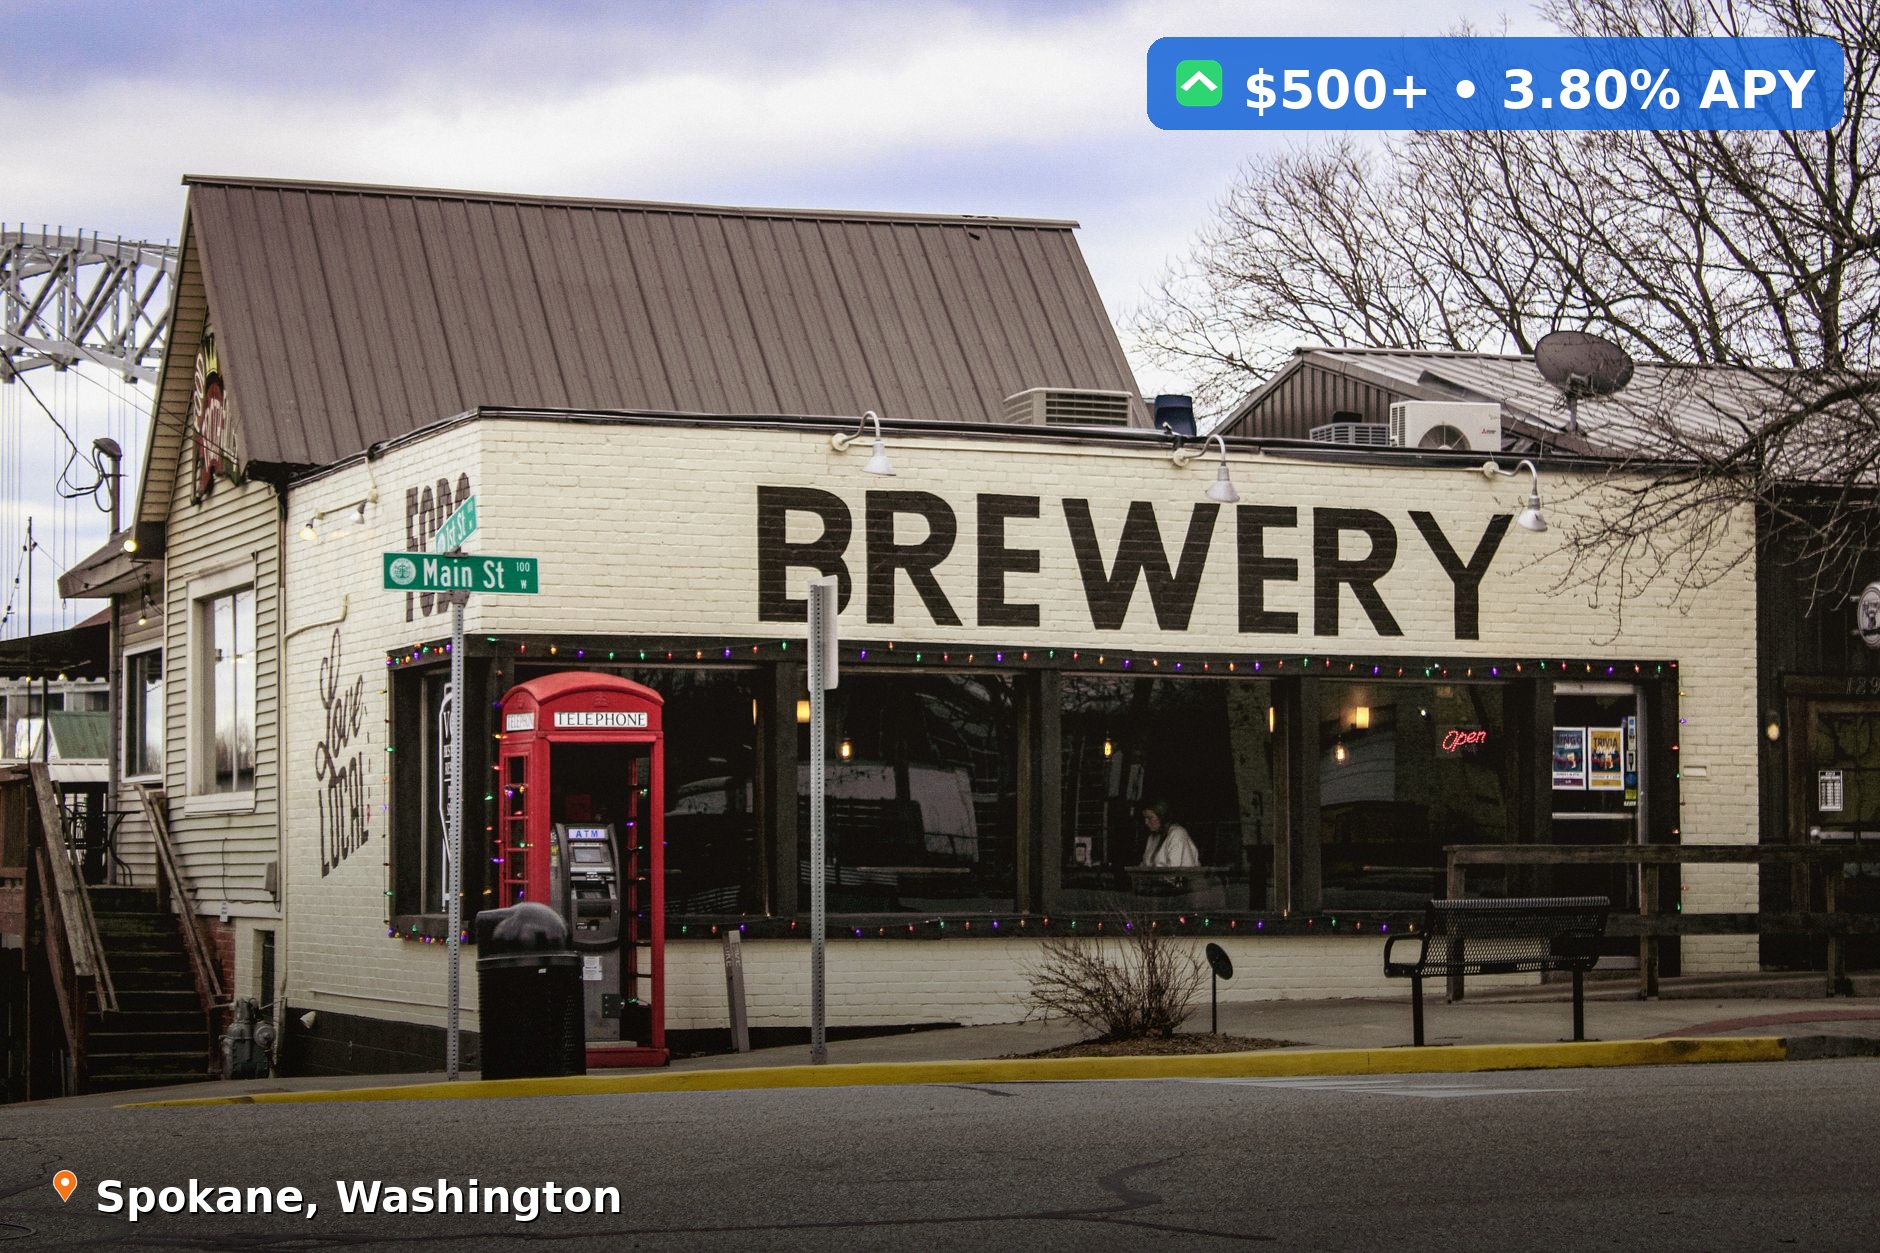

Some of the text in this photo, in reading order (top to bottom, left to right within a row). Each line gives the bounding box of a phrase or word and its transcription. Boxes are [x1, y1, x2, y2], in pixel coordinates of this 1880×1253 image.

[446, 510, 467, 552] 1st St
[423, 558, 473, 587] Main
[483, 560, 505, 589] St
[516, 562, 530, 572] 100
[758, 486, 1513, 640] BREWERY
[521, 579, 527, 589] W
[315, 627, 364, 786] Love
[558, 712, 646, 727] TELEPHONE
[1442, 729, 1487, 752] Open
[1593, 737, 1618, 748] TRIVIA
[319, 752, 369, 879] LOCAL
[575, 830, 598, 838] ATM
